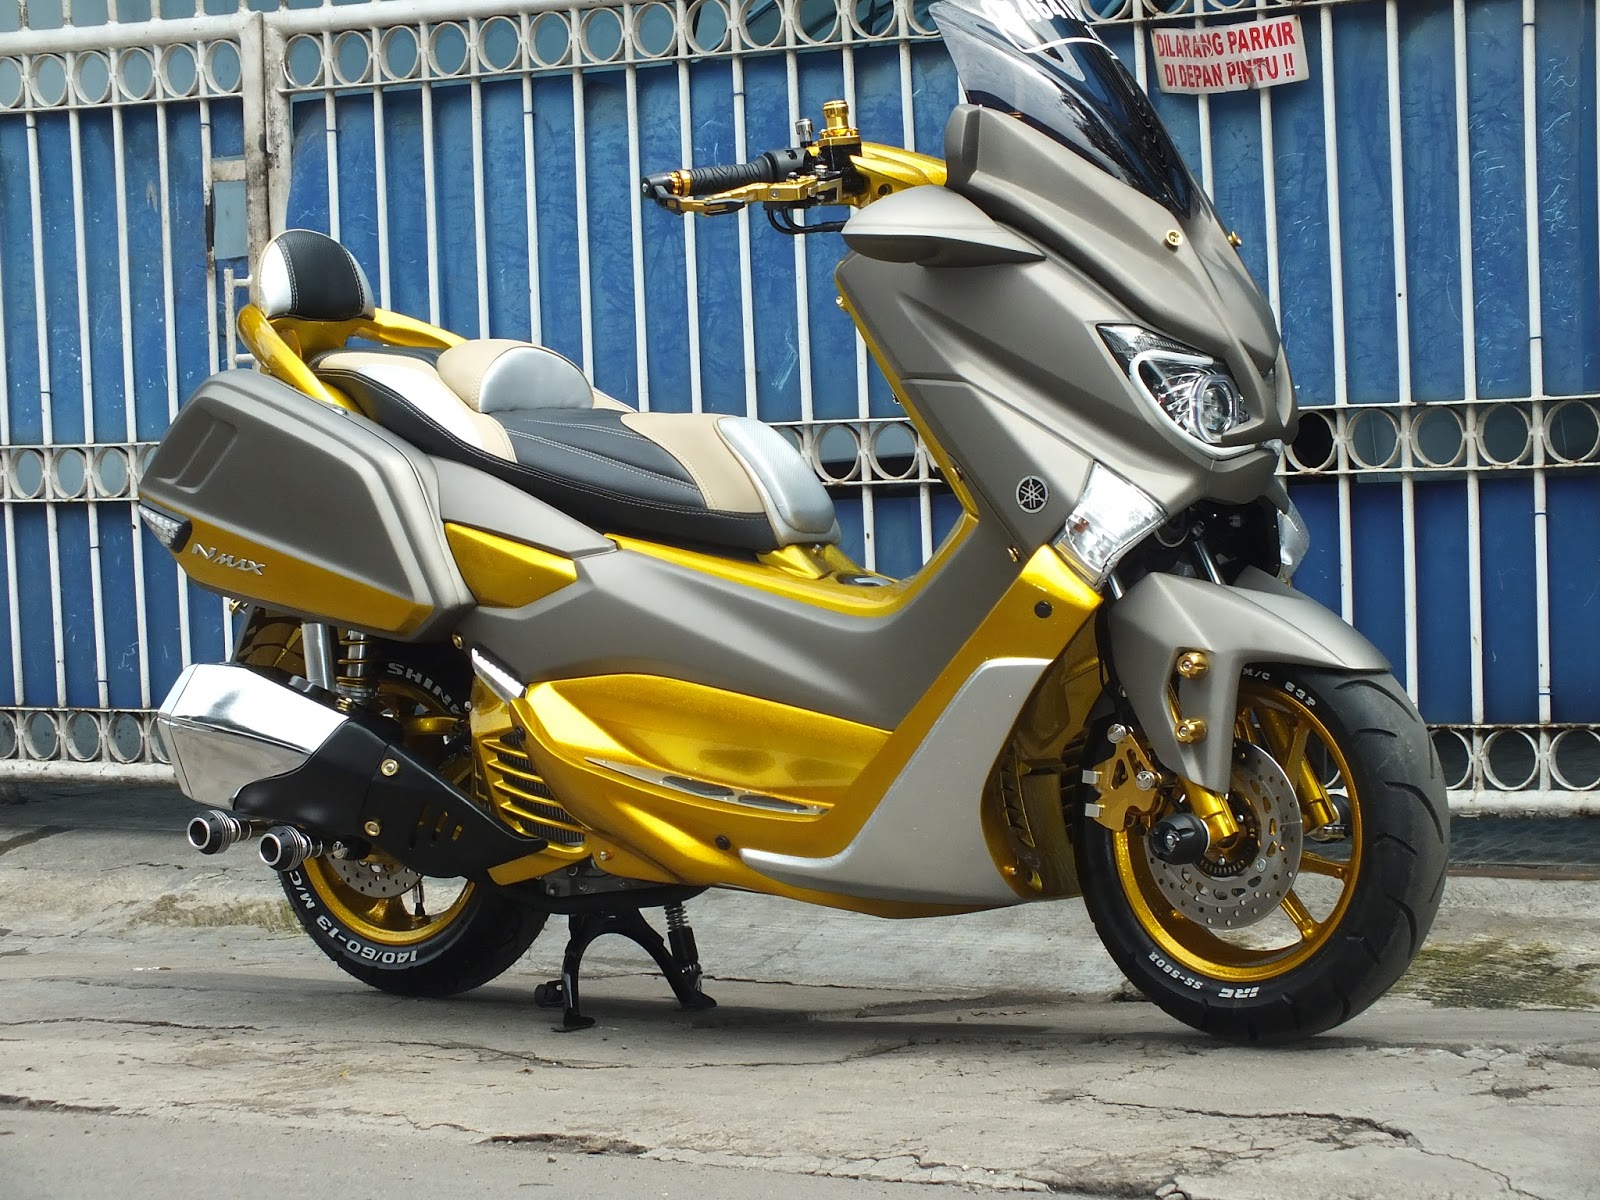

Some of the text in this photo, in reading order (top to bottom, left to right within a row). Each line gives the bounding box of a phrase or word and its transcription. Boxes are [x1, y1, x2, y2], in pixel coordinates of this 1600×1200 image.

[1156, 21, 1296, 58] DILARANG PARKIR
[1164, 63, 1178, 87] DI
[1178, 62, 1225, 88] DEPAN
[1225, 53, 1279, 85] PINTU
[191, 543, 266, 576] NMAX
[289, 870, 418, 964] 140/60-13 M/C
[1148, 952, 1204, 990] SS-560R
